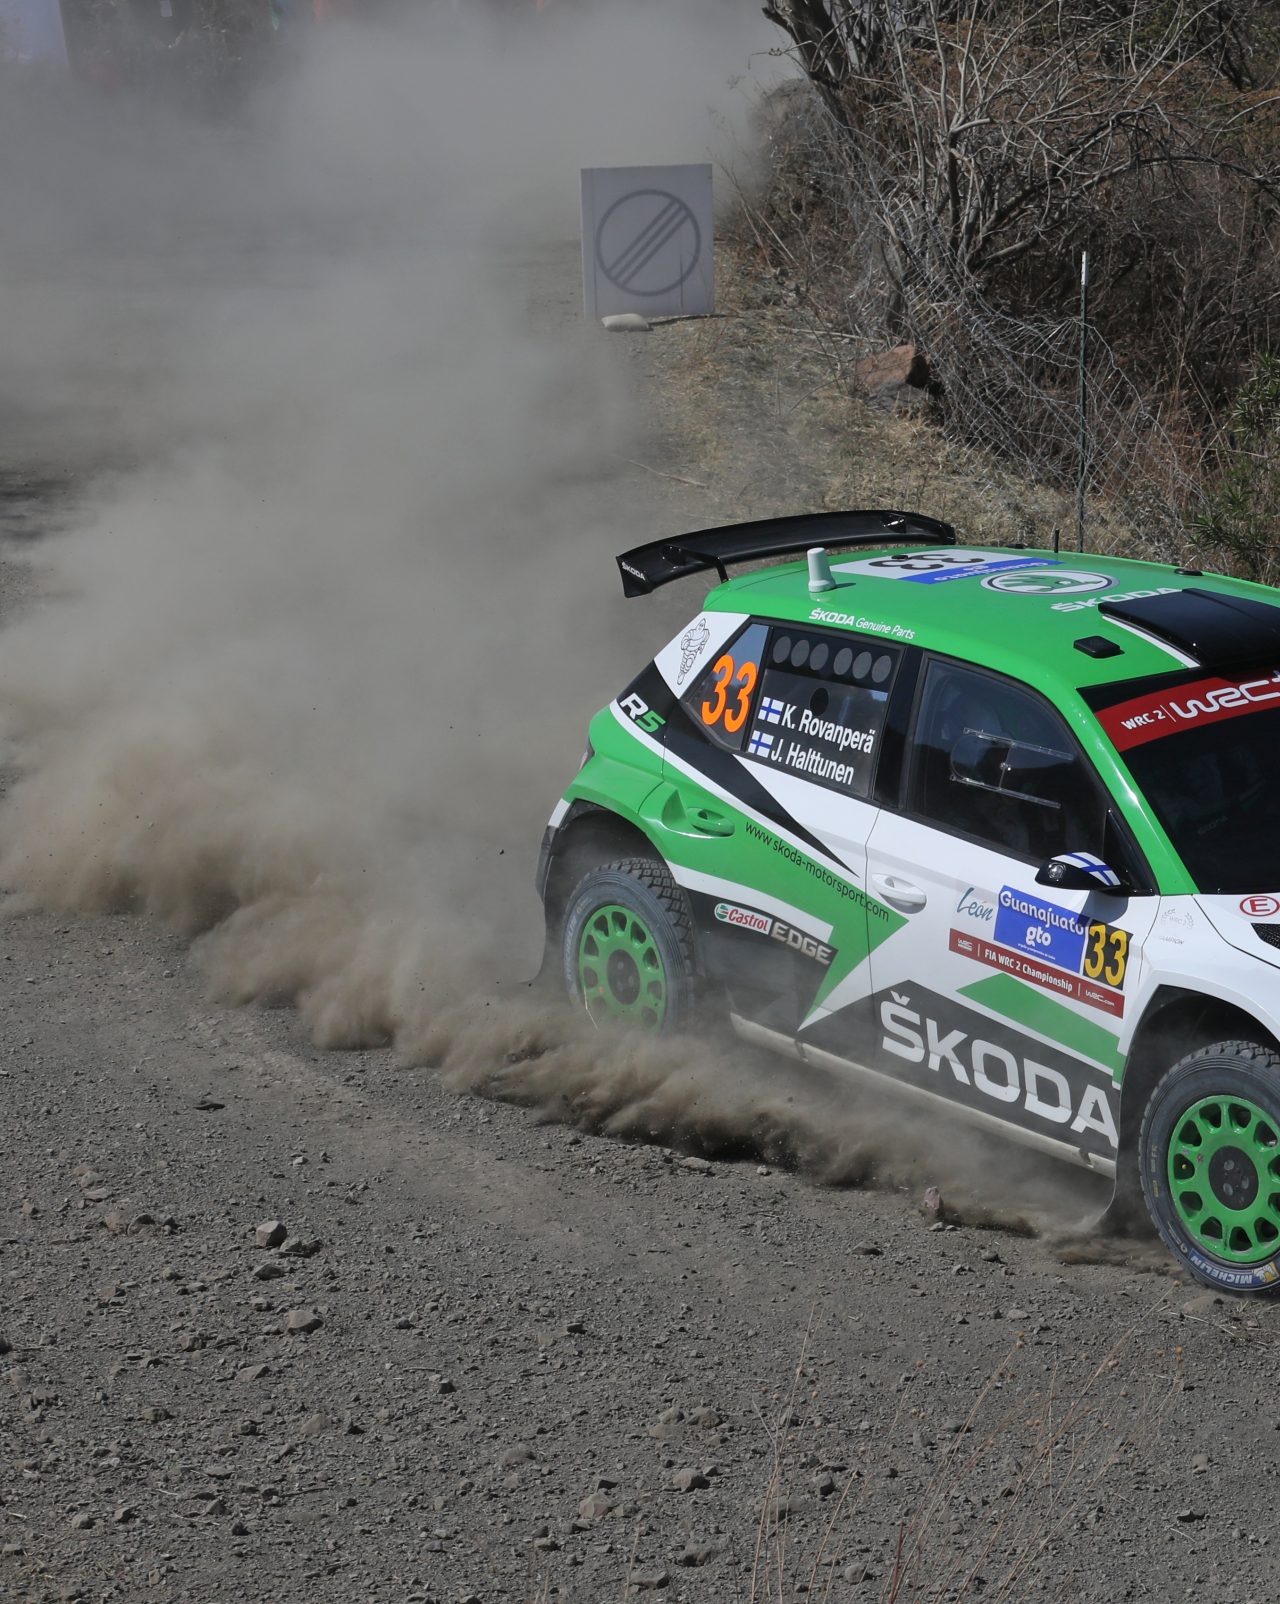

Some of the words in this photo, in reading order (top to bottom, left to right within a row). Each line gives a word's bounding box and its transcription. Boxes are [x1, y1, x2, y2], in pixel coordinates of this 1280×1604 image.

[808, 608, 854, 627] ŠKODA
[855, 617, 891, 635] Genuine
[892, 625, 915, 640] Parts
[619, 692, 667, 733] R5
[702, 655, 758, 733] 33
[781, 703, 796, 731] K.
[799, 708, 876, 754] Rovanperä
[1121, 712, 1153, 731] WRC
[1152, 709, 1166, 720] 2
[771, 738, 784, 763] J.
[786, 743, 855, 785] Halttunen
[1000, 890, 1085, 936] Guanajuato
[1250, 898, 1270, 913] E
[727, 908, 769, 932] Castrol
[771, 922, 832, 965] EDGE
[1026, 926, 1051, 947] gto
[1084, 924, 1128, 986] 33
[984, 948, 996, 962] FIA
[998, 953, 1014, 968] WRC
[1015, 961, 1021, 971] 2
[1022, 964, 1073, 993] Championship
[880, 990, 1120, 1149] ŠKODA
[1190, 1255, 1253, 1285] MICHELIN
